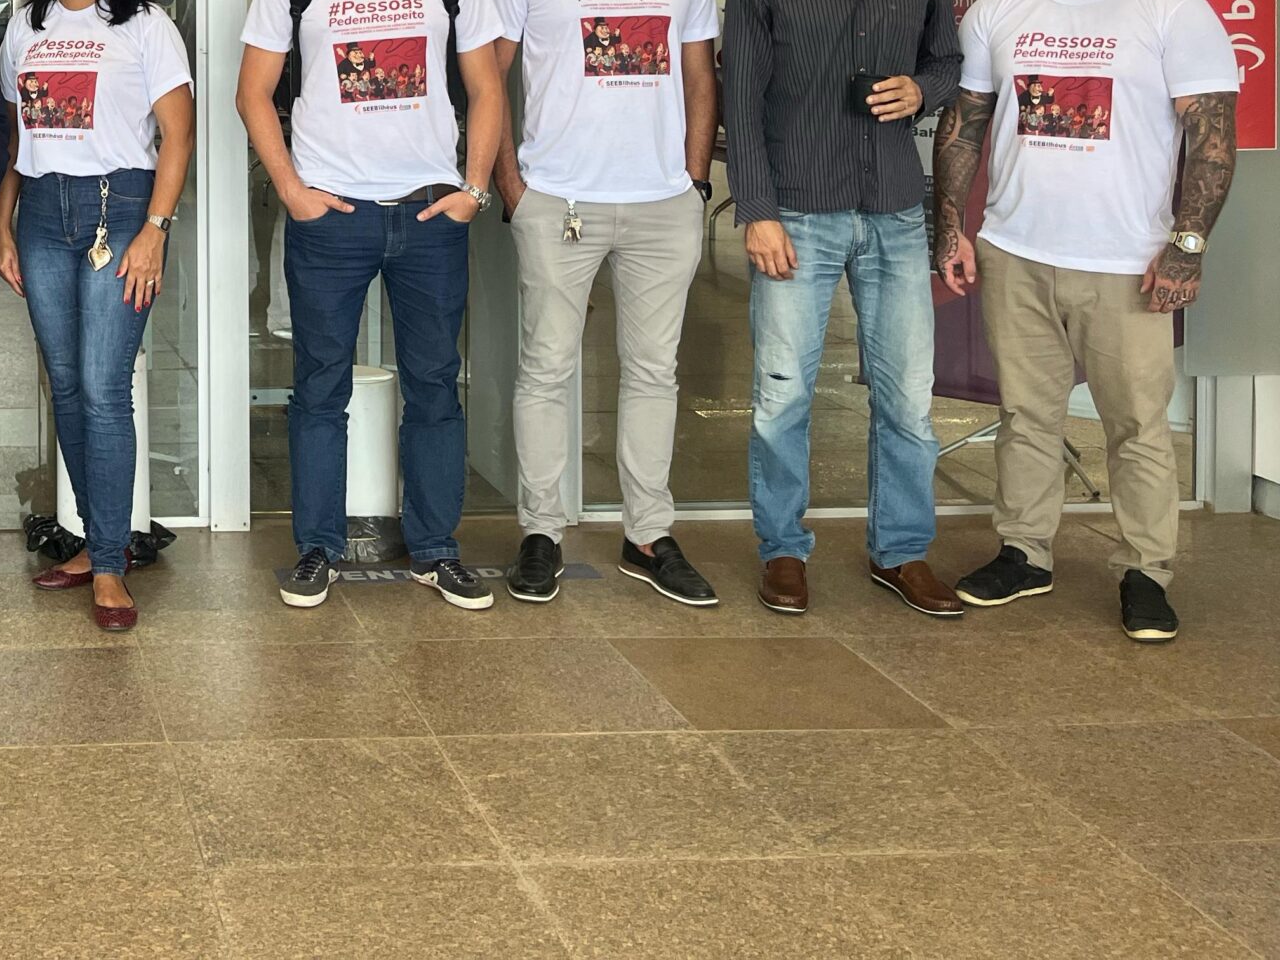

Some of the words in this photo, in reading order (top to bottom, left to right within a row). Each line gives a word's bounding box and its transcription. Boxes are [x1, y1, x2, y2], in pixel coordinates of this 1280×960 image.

[329, 11, 424, 27] PedemRespeito
[1015, 32, 1118, 49] #Pessoas
[1013, 48, 1114, 60] PedemRespeito
